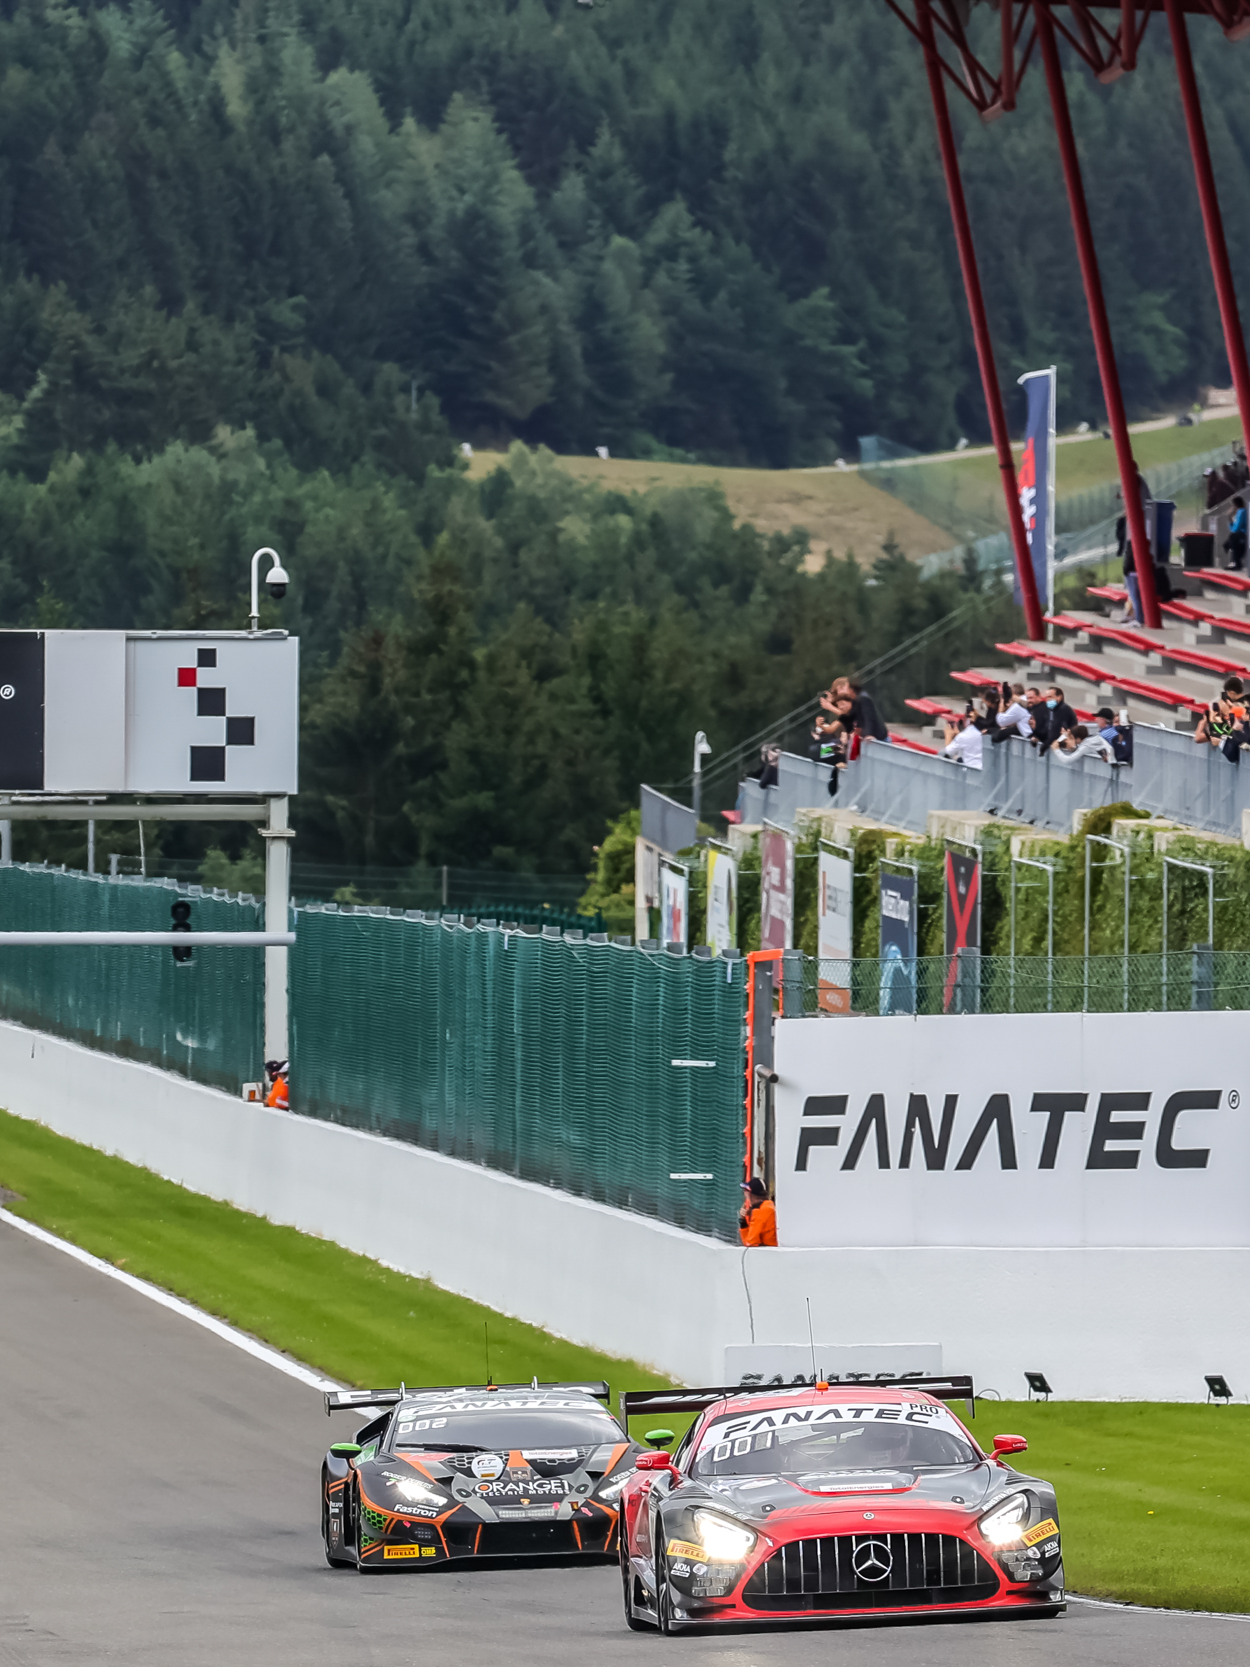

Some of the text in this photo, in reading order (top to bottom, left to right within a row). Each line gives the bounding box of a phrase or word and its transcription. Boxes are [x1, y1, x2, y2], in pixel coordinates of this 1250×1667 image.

[412, 1399, 587, 1415] FANATEC
[910, 1402, 940, 1415] PRO
[398, 1417, 447, 1434] 002
[722, 1407, 932, 1440] FANATEC
[475, 1479, 570, 1493] ORANGE1
[477, 1489, 524, 1497] ELECTRIC
[394, 1504, 437, 1518] Fastron
[1026, 1522, 1055, 1542] PIRELLI
[387, 1547, 416, 1557] PIRELLI
[671, 1542, 705, 1559] PIRELLI
